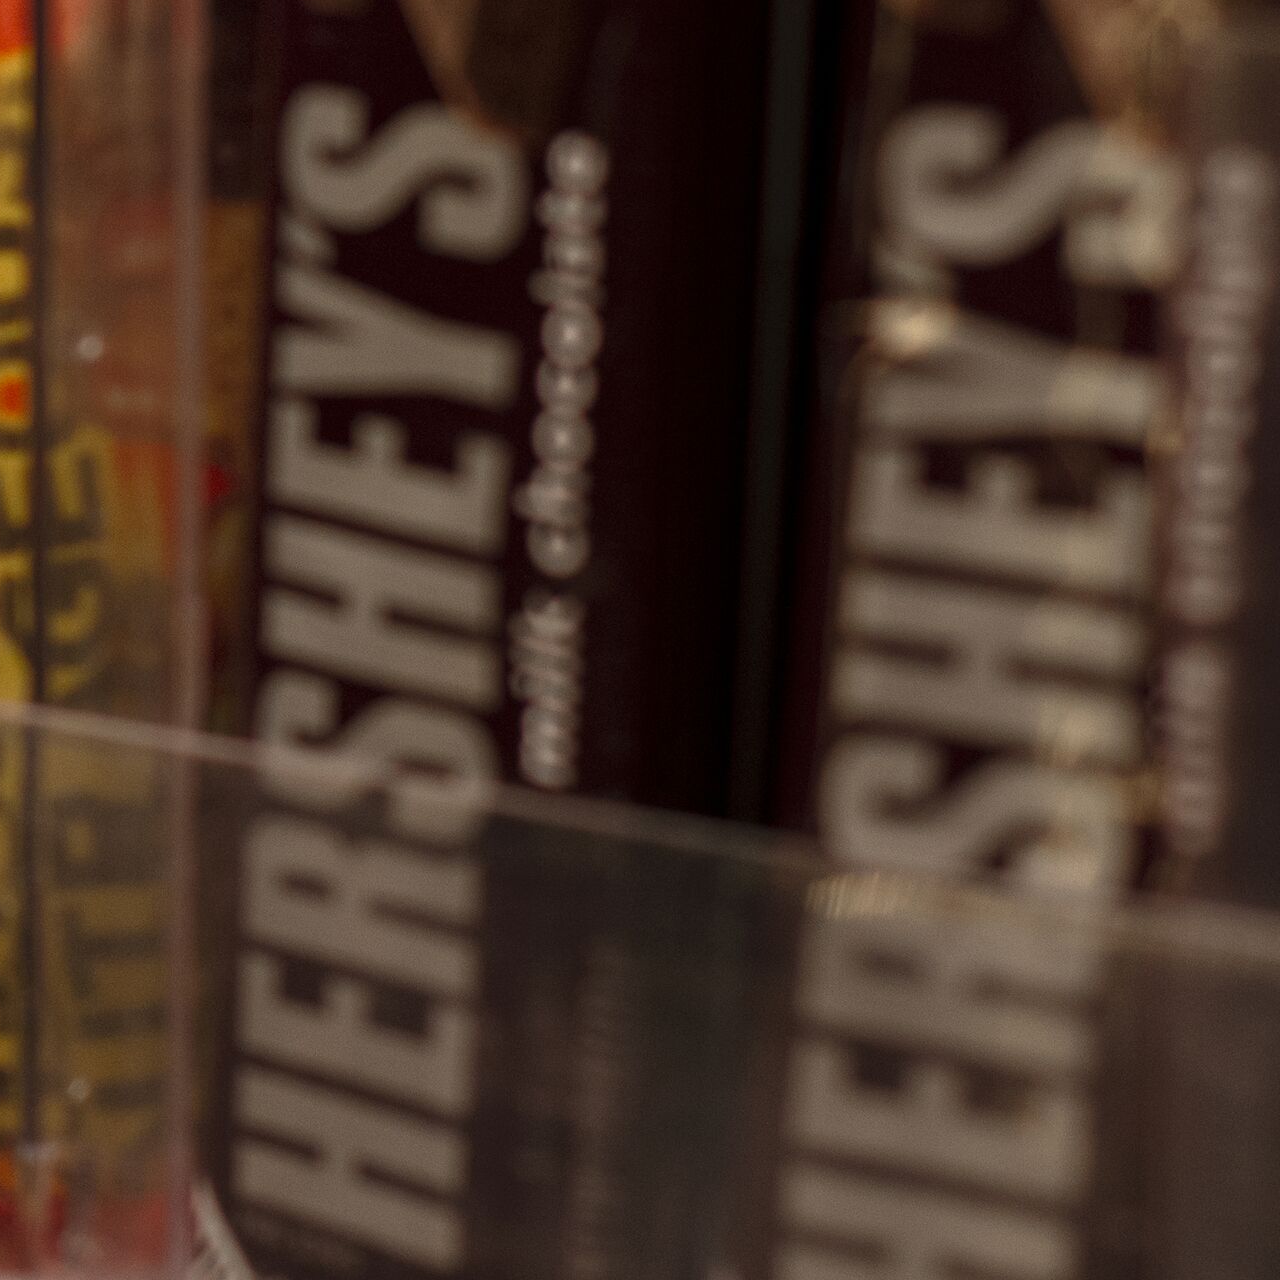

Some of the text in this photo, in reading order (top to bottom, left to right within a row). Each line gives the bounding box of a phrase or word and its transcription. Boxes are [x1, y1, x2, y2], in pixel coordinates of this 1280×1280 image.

[233, 80, 529, 1273] HERSHEY'S
[509, 125, 611, 791] milk chocolate
[774, 101, 1190, 1280] HERSHEY'S
